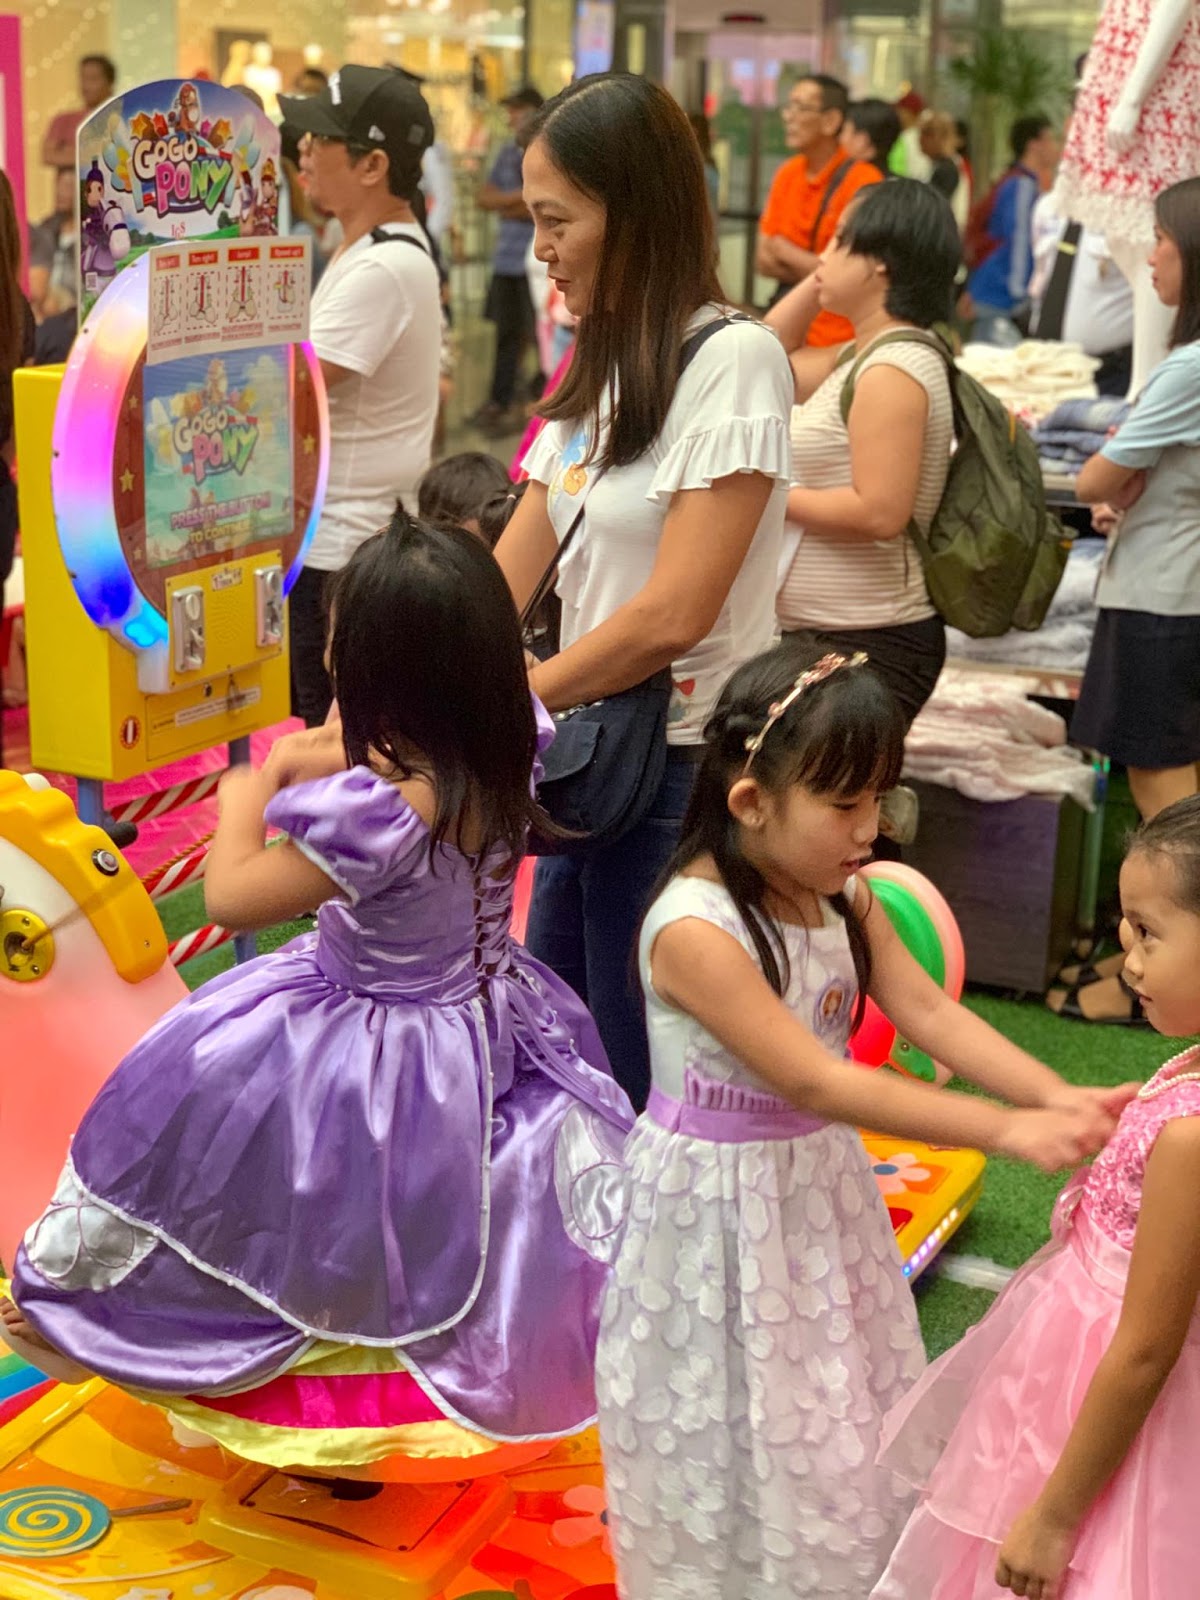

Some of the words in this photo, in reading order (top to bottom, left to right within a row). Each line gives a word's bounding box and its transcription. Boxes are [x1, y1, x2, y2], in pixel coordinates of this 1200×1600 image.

[133, 136, 198, 181] GOGO
[155, 160, 232, 215] PONY
[173, 409, 227, 453] GOGO
[192, 425, 258, 484] PONY
[171, 506, 204, 529] PRESS
[190, 530, 204, 543] TO
